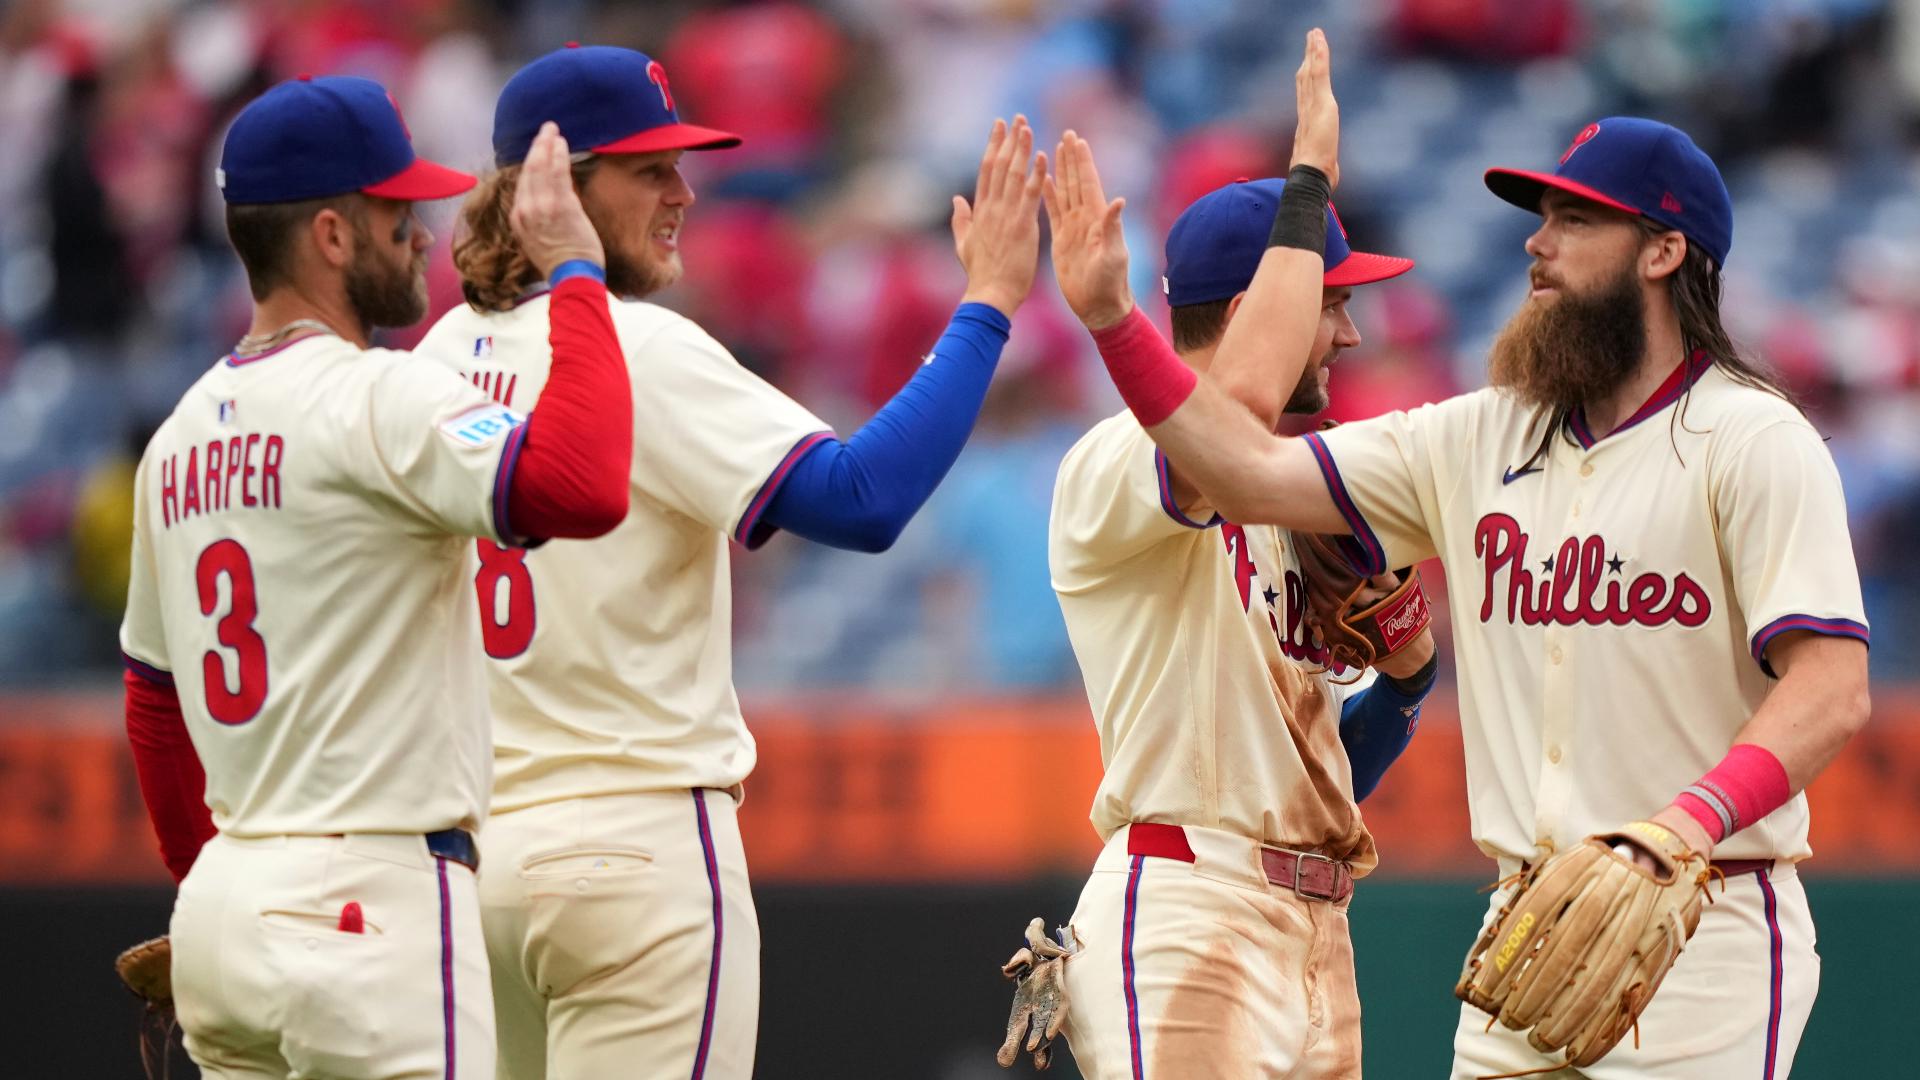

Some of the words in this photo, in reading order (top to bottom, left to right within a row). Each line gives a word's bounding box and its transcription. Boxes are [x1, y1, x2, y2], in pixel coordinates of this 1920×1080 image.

[161, 433, 283, 529] HARPER
[1474, 512, 1711, 627] Phillies
[196, 538, 268, 726] 3
[1495, 911, 1536, 972] A2000
